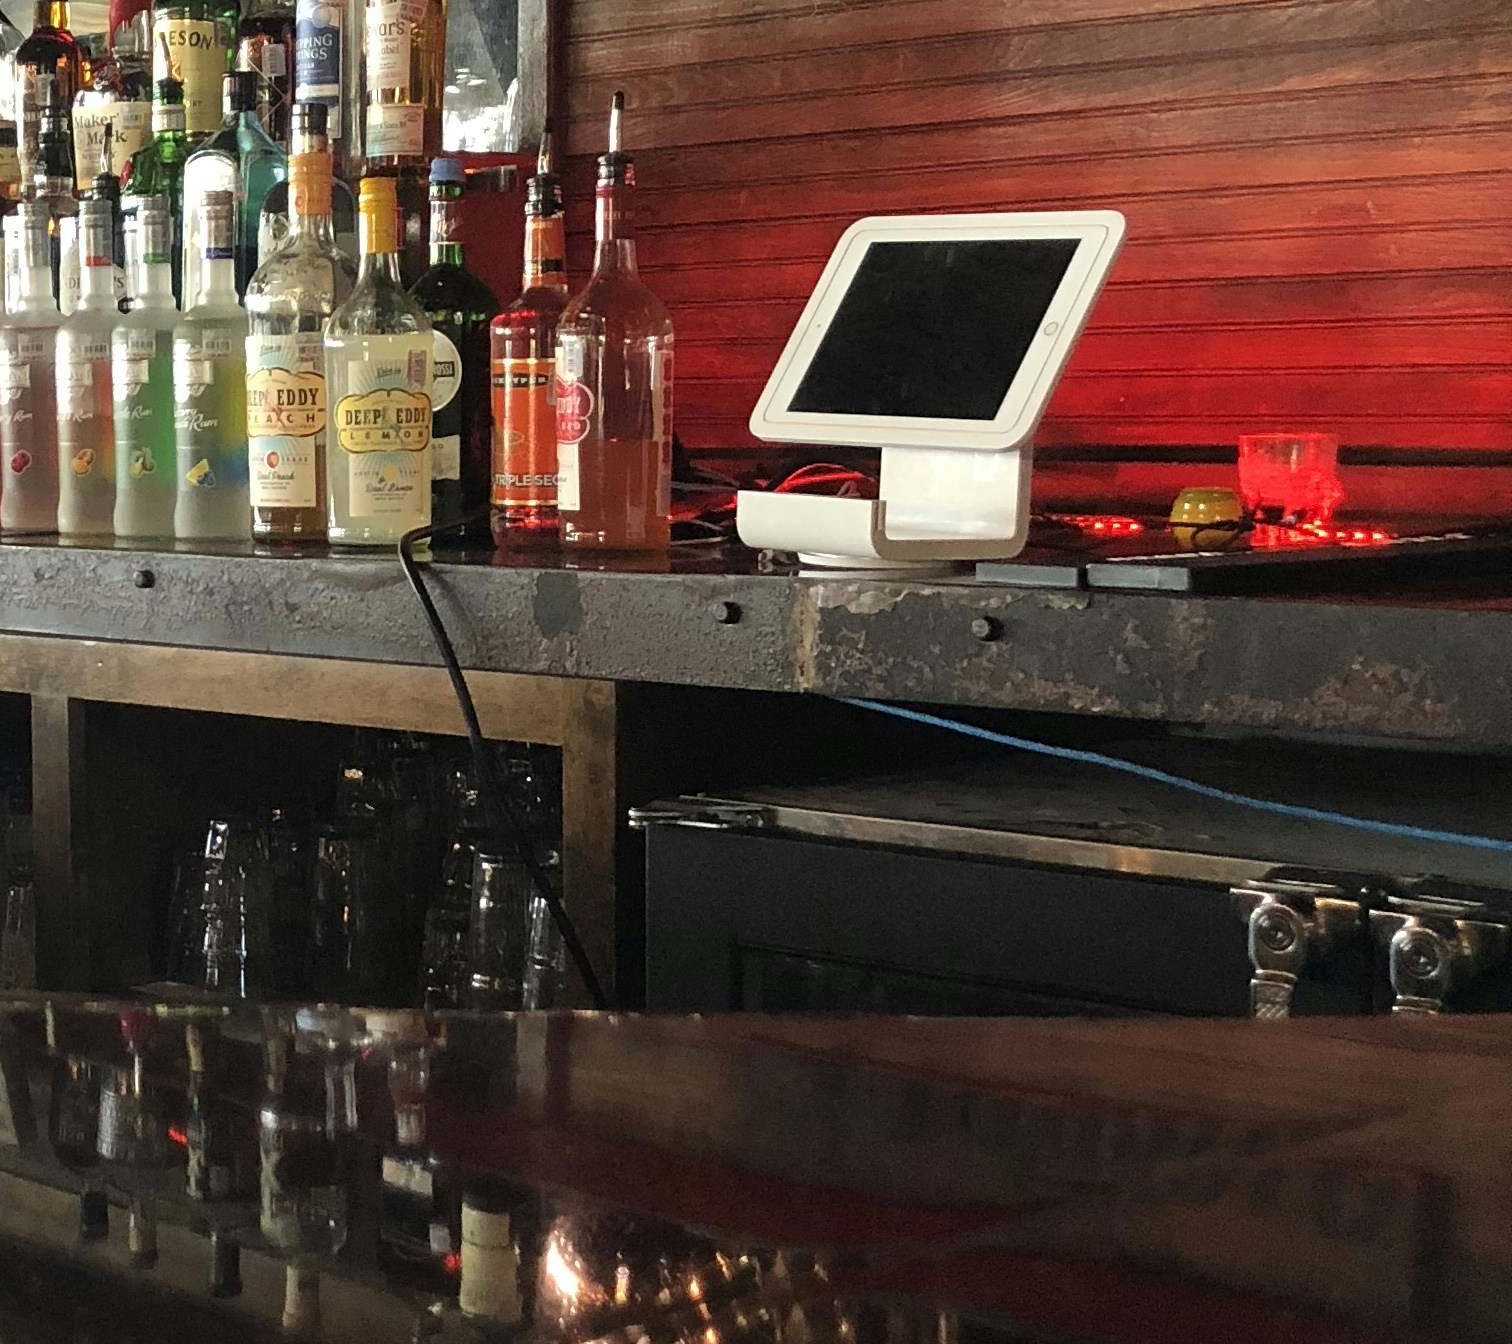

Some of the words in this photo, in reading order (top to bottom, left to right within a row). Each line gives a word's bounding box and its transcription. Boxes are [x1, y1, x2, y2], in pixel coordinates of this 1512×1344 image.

[87, 129, 128, 144] Mak
[276, 388, 320, 407] EDDY
[188, 413, 219, 432] Rum
[345, 408, 382, 426] DEEP
[395, 407, 427, 424] EDDY
[495, 473, 532, 487] TRIPLE
